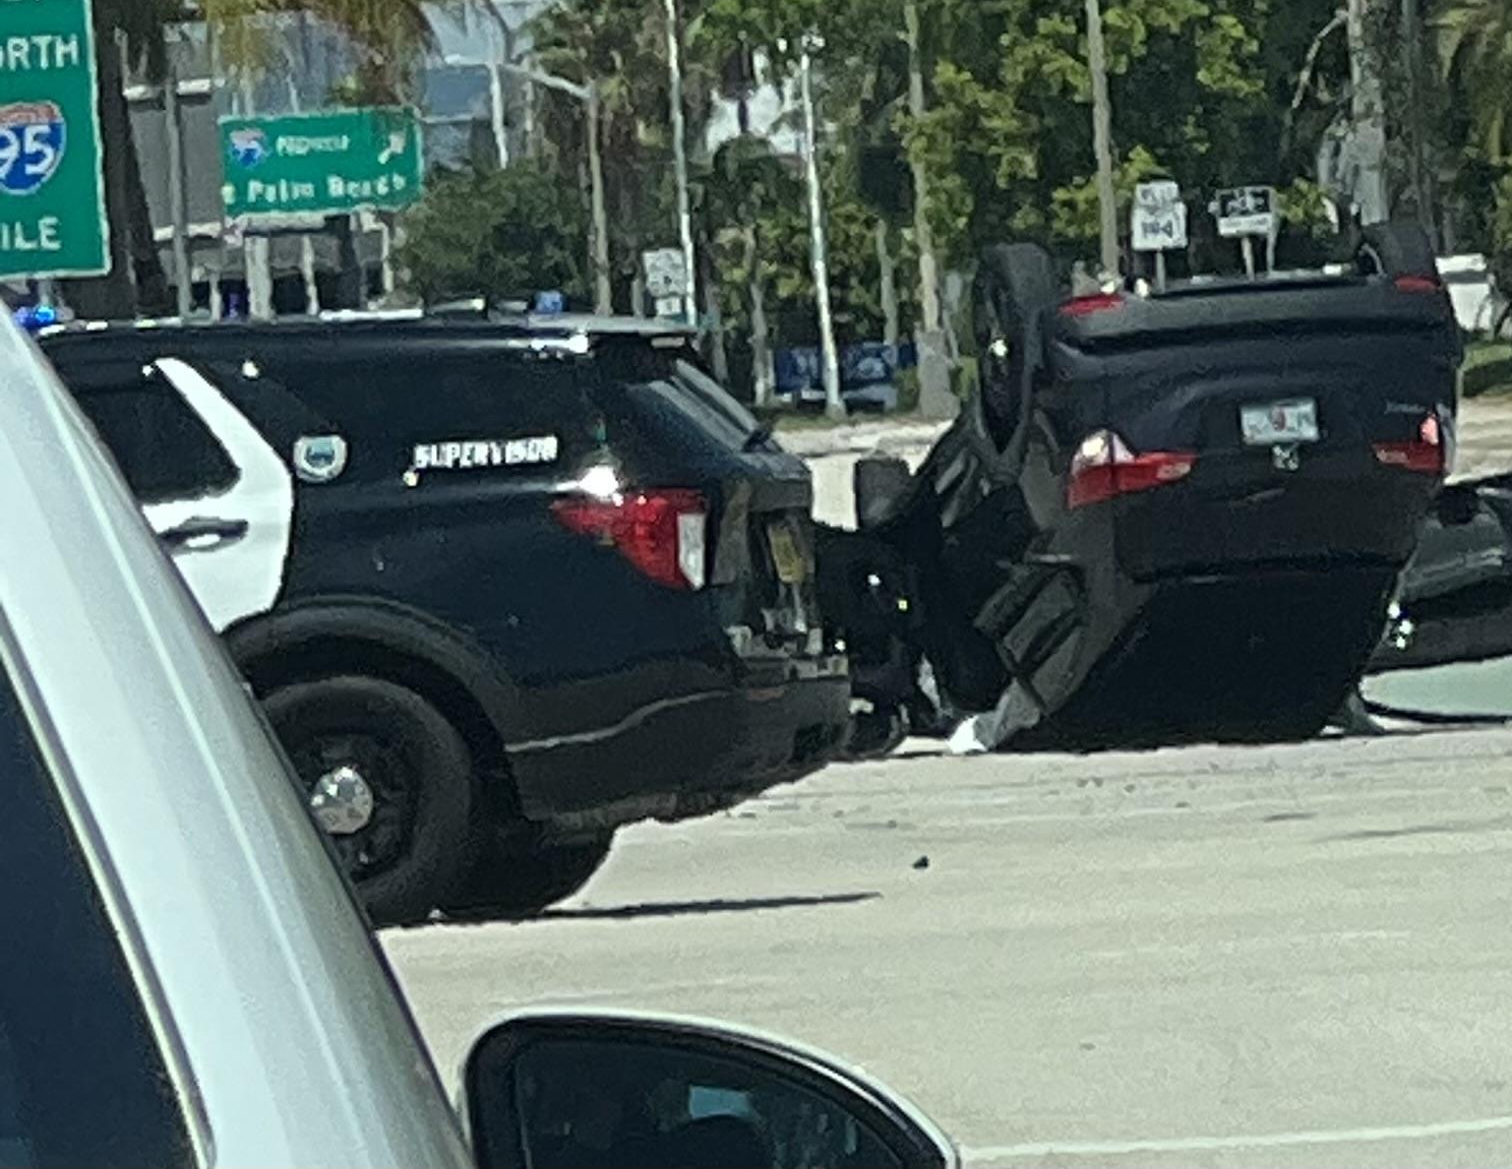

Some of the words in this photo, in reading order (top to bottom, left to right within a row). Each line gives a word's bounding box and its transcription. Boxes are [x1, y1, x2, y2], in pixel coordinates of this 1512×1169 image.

[0, 33, 79, 70] RTH
[0, 124, 55, 178] 95
[0, 216, 62, 251] ILE
[414, 435, 558, 471] SUPERVISOR
